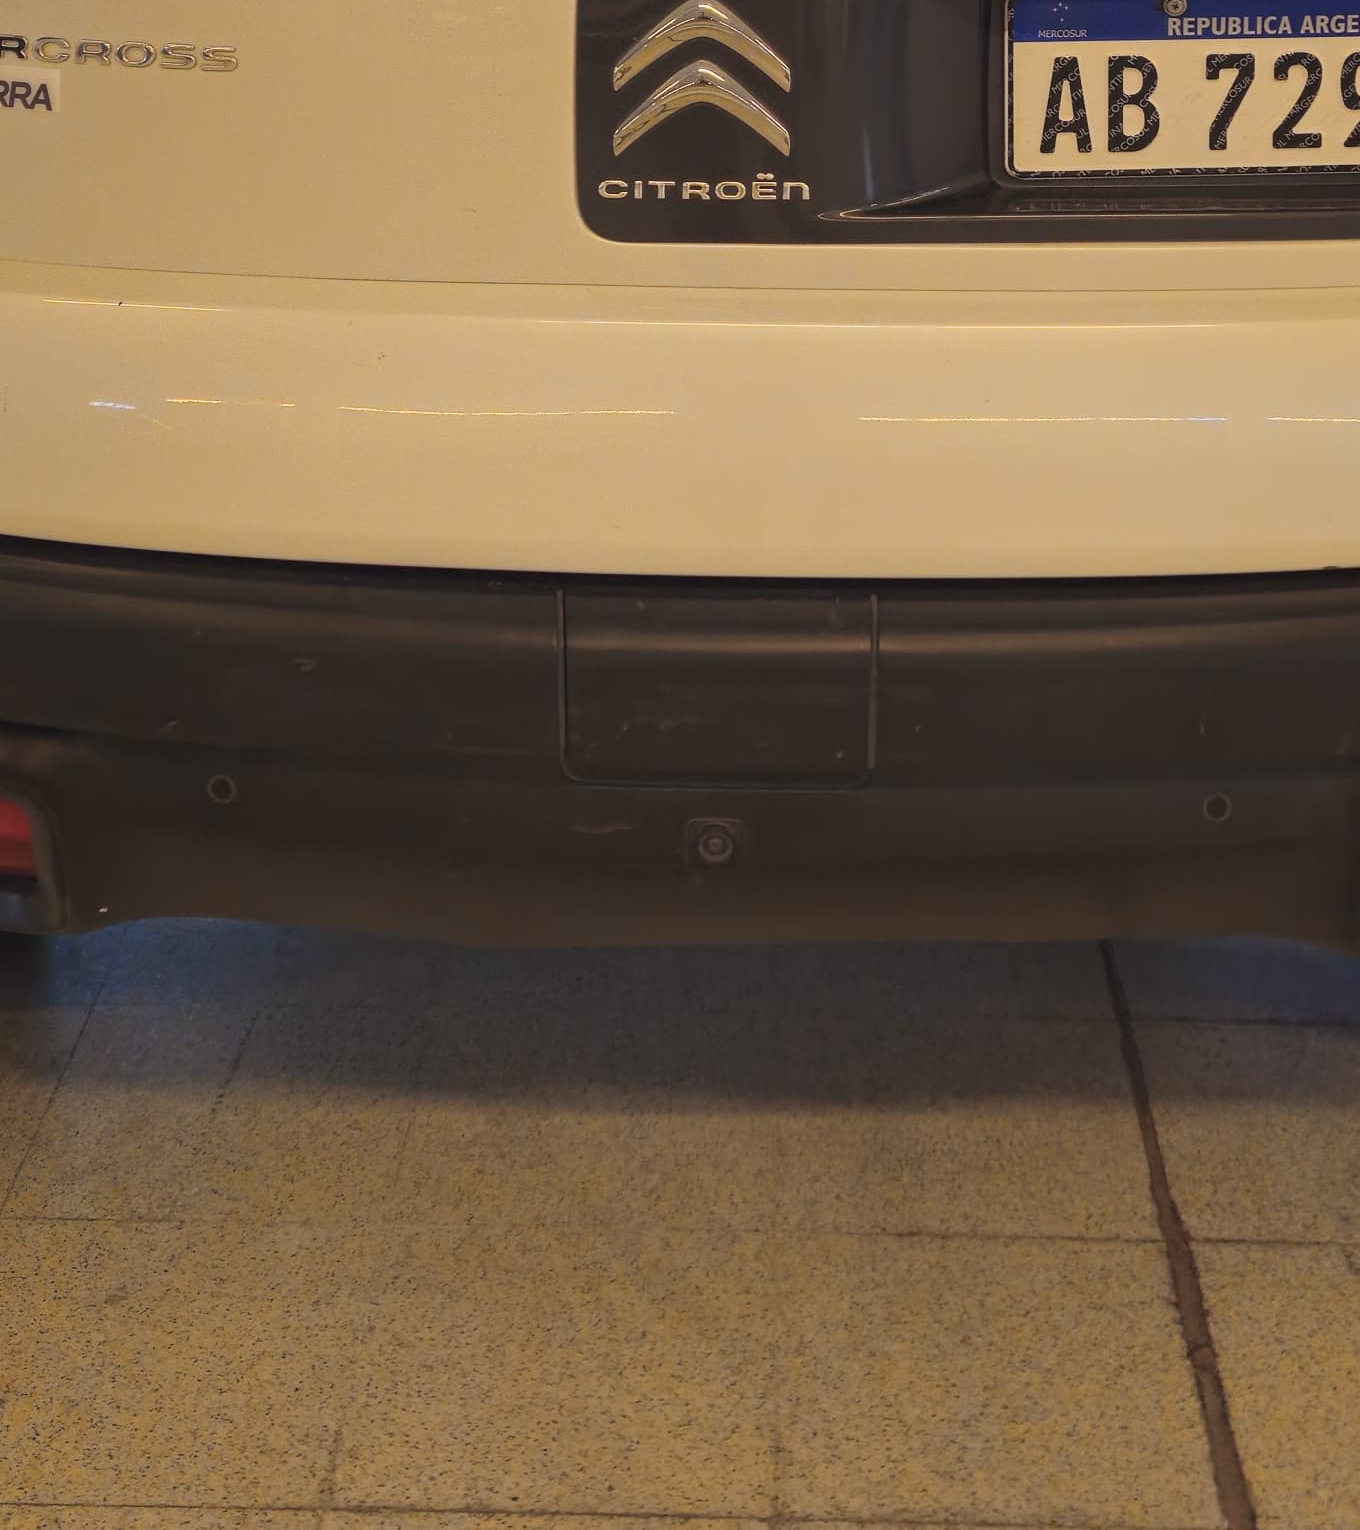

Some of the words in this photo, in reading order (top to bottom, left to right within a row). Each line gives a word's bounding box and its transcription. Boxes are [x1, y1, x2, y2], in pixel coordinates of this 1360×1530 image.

[1037, 29, 1088, 38] MERCOSUR
[1166, 15, 1292, 37] REPUBLICA
[1039, 54, 1160, 154] AB
[598, 172, 810, 200] CITROËN
